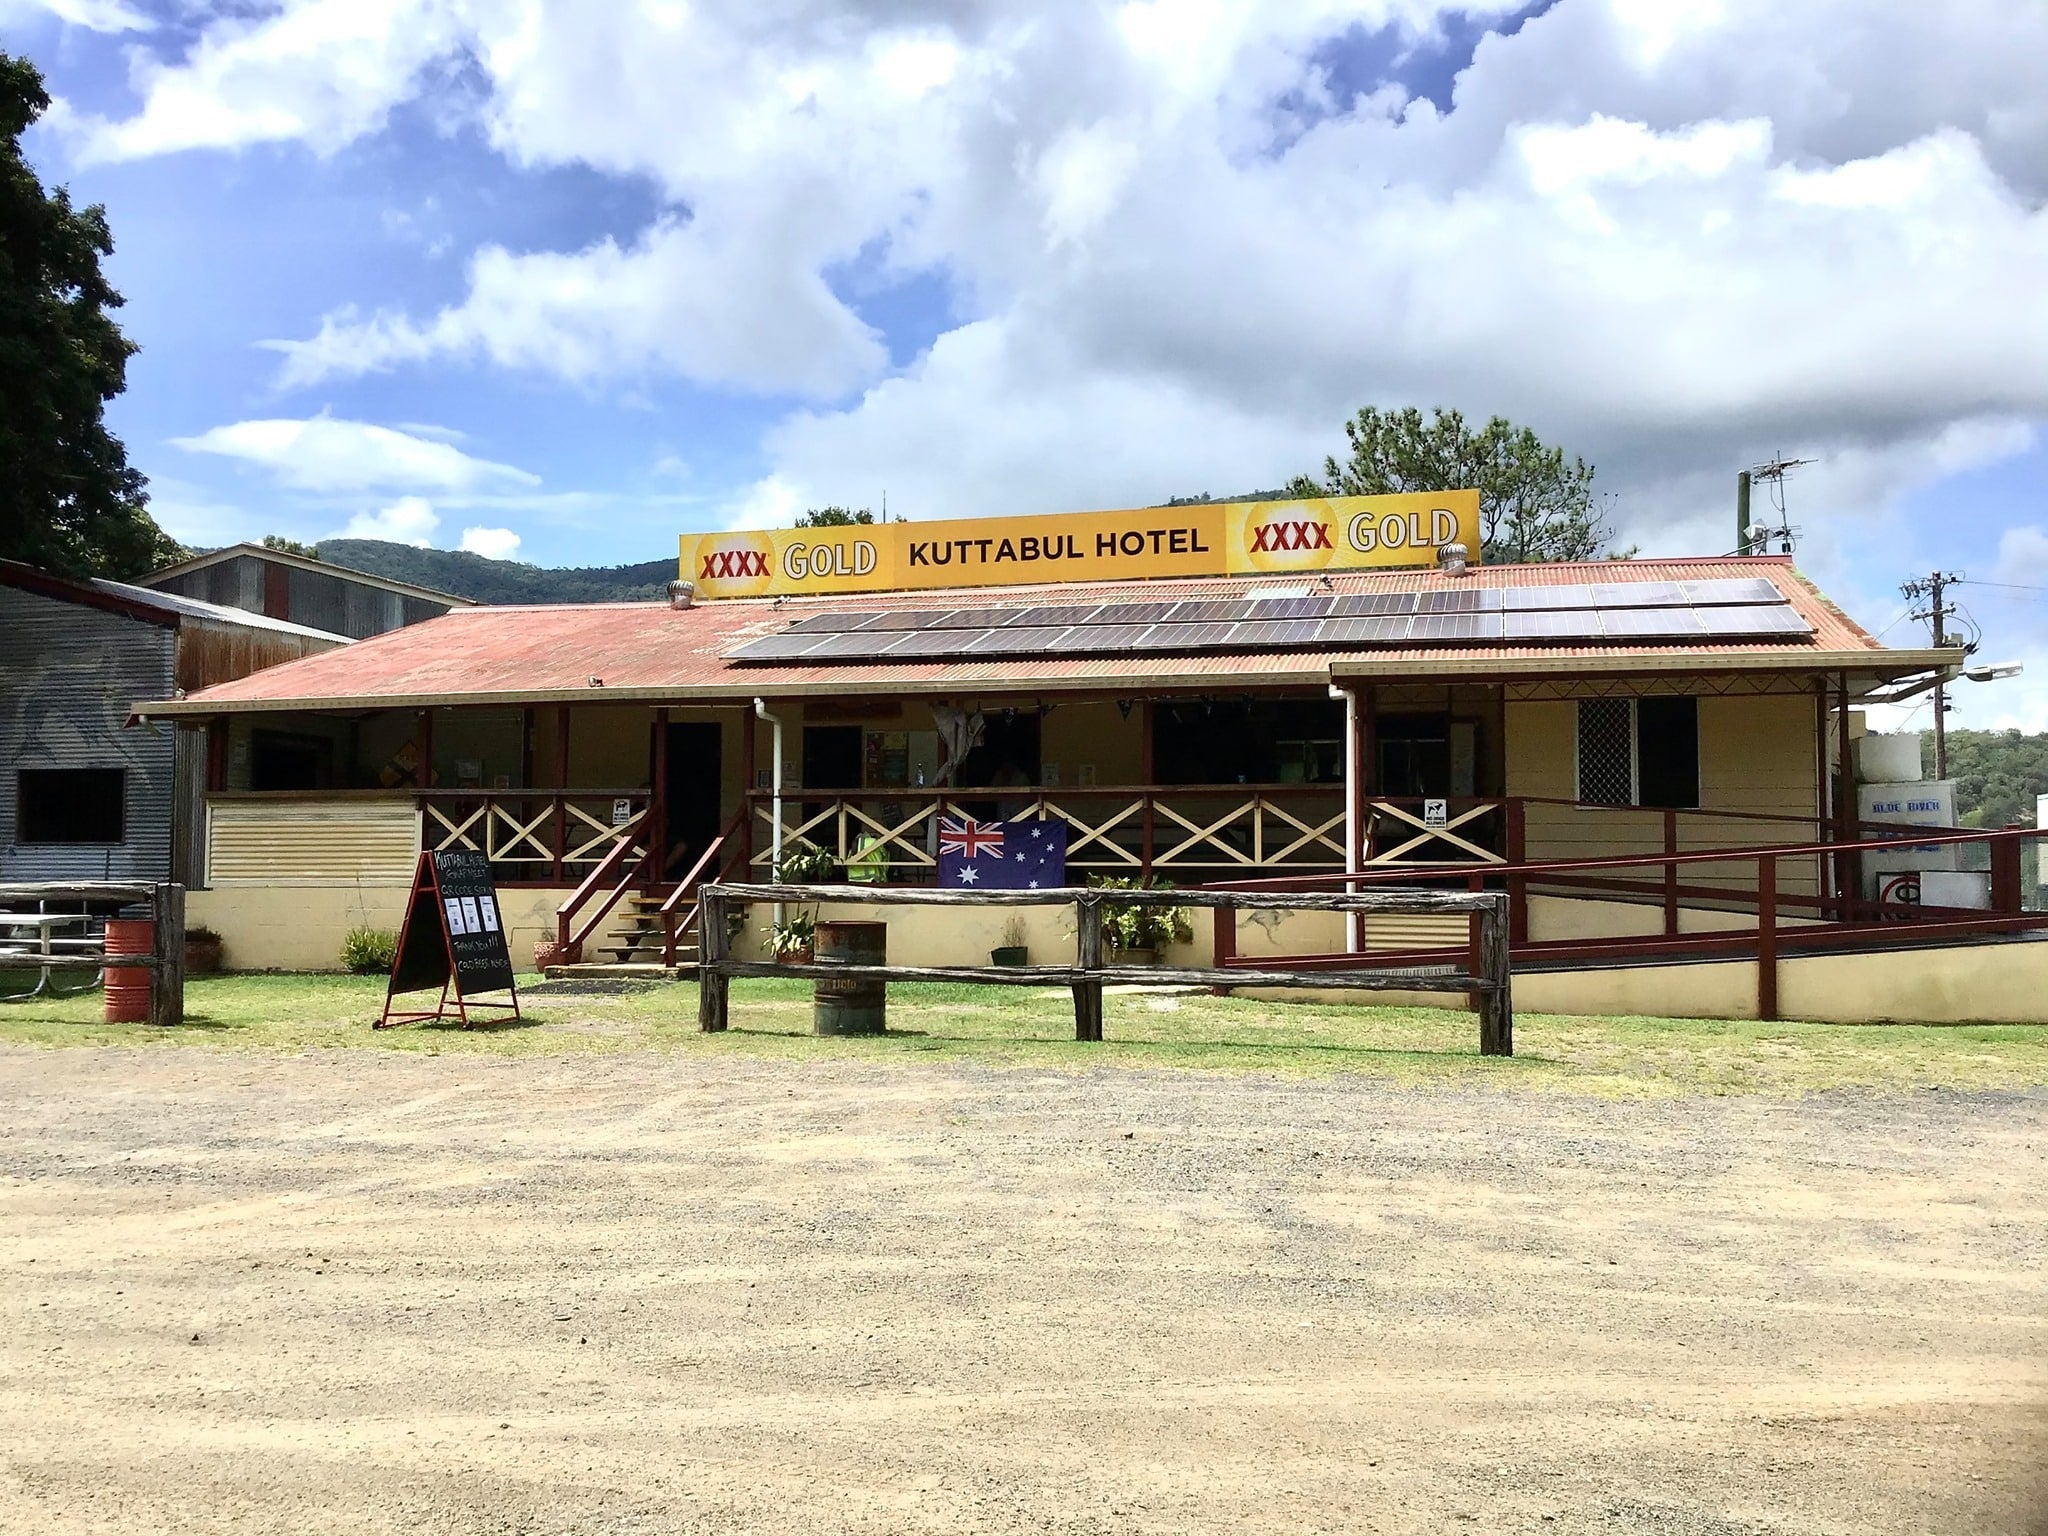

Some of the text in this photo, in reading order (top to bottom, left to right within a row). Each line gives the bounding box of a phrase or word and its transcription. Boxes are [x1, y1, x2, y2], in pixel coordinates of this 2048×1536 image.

[700, 509, 1458, 579] XXXX GOLD KUTTABUL HOTEL XXXX GOLD
[1872, 799, 1940, 813] BLUE RIVER
[458, 960, 474, 972] COLD
